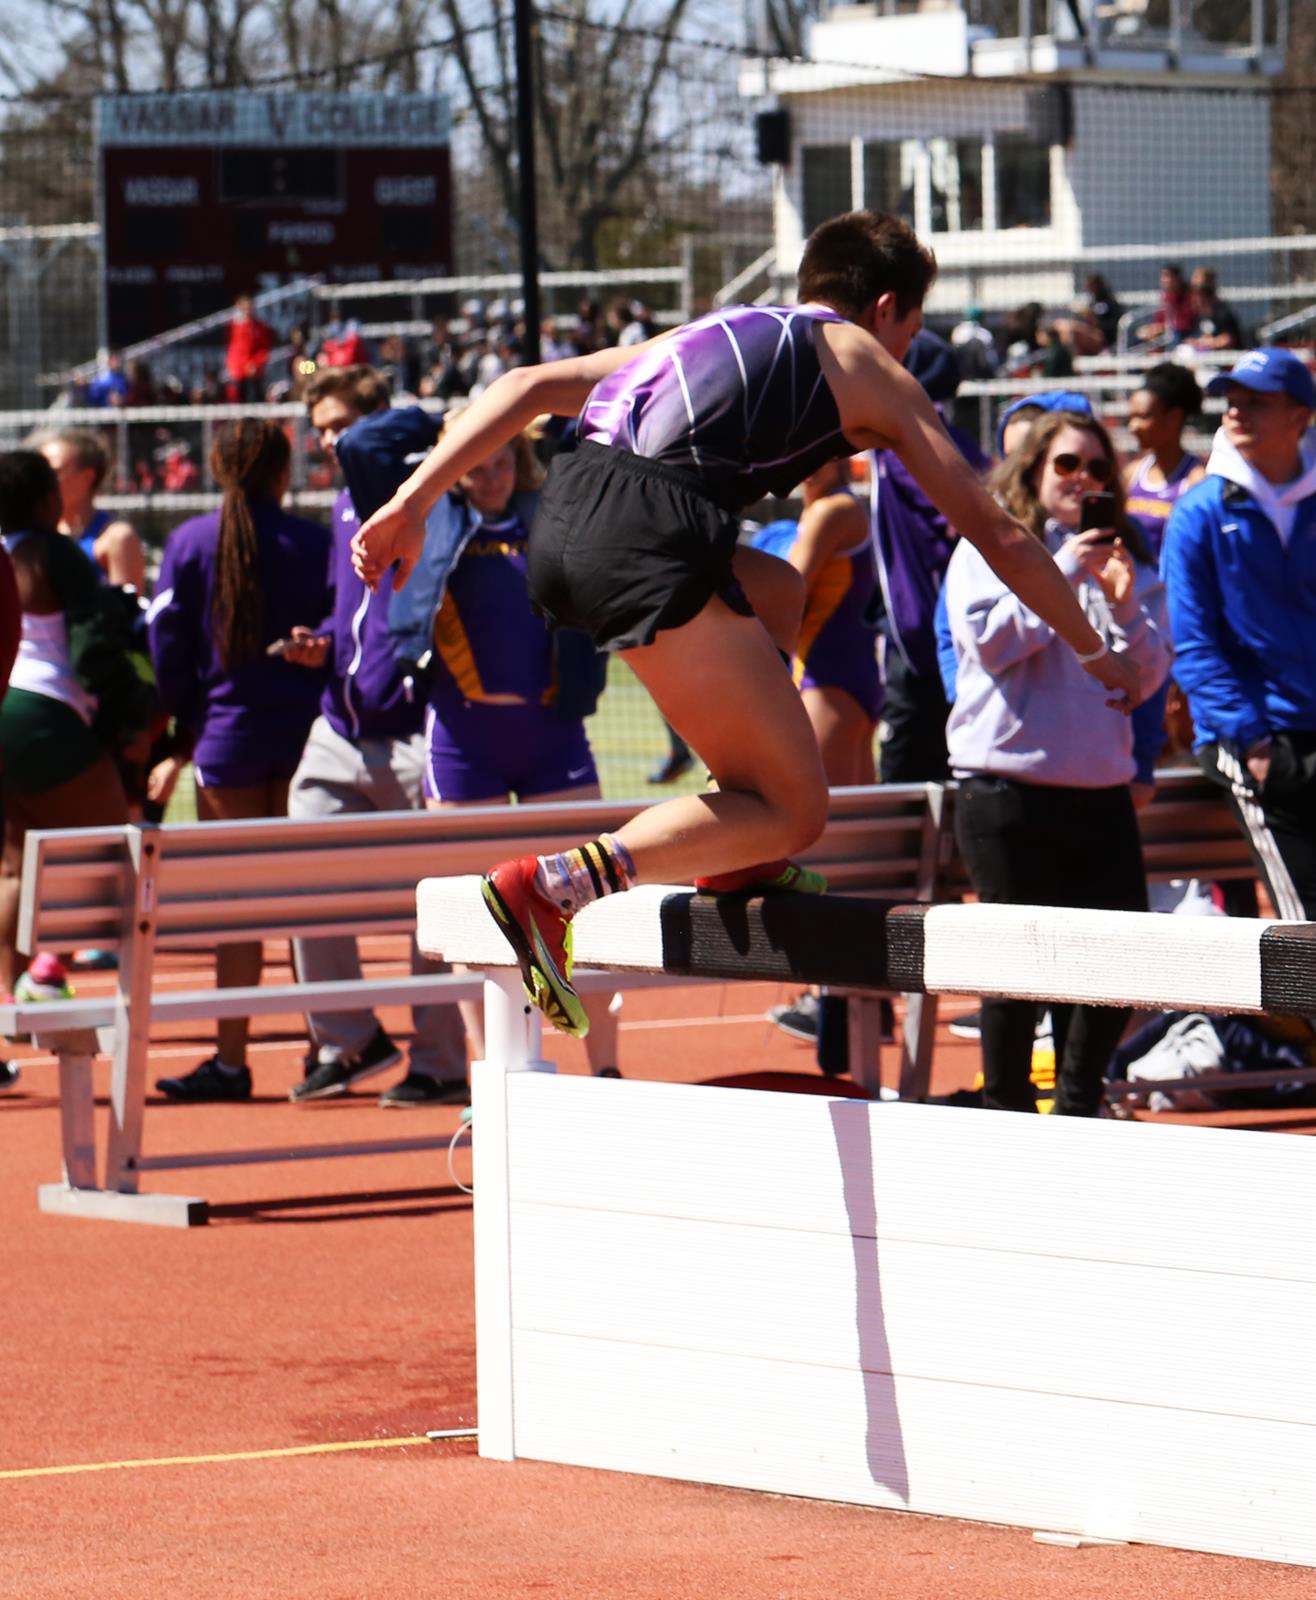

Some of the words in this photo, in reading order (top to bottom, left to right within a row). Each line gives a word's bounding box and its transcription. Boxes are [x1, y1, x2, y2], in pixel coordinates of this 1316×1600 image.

[115, 98, 236, 132] VASSAR
[266, 95, 296, 138] V
[307, 98, 442, 132] COLLEGE
[375, 176, 437, 205] GUEST
